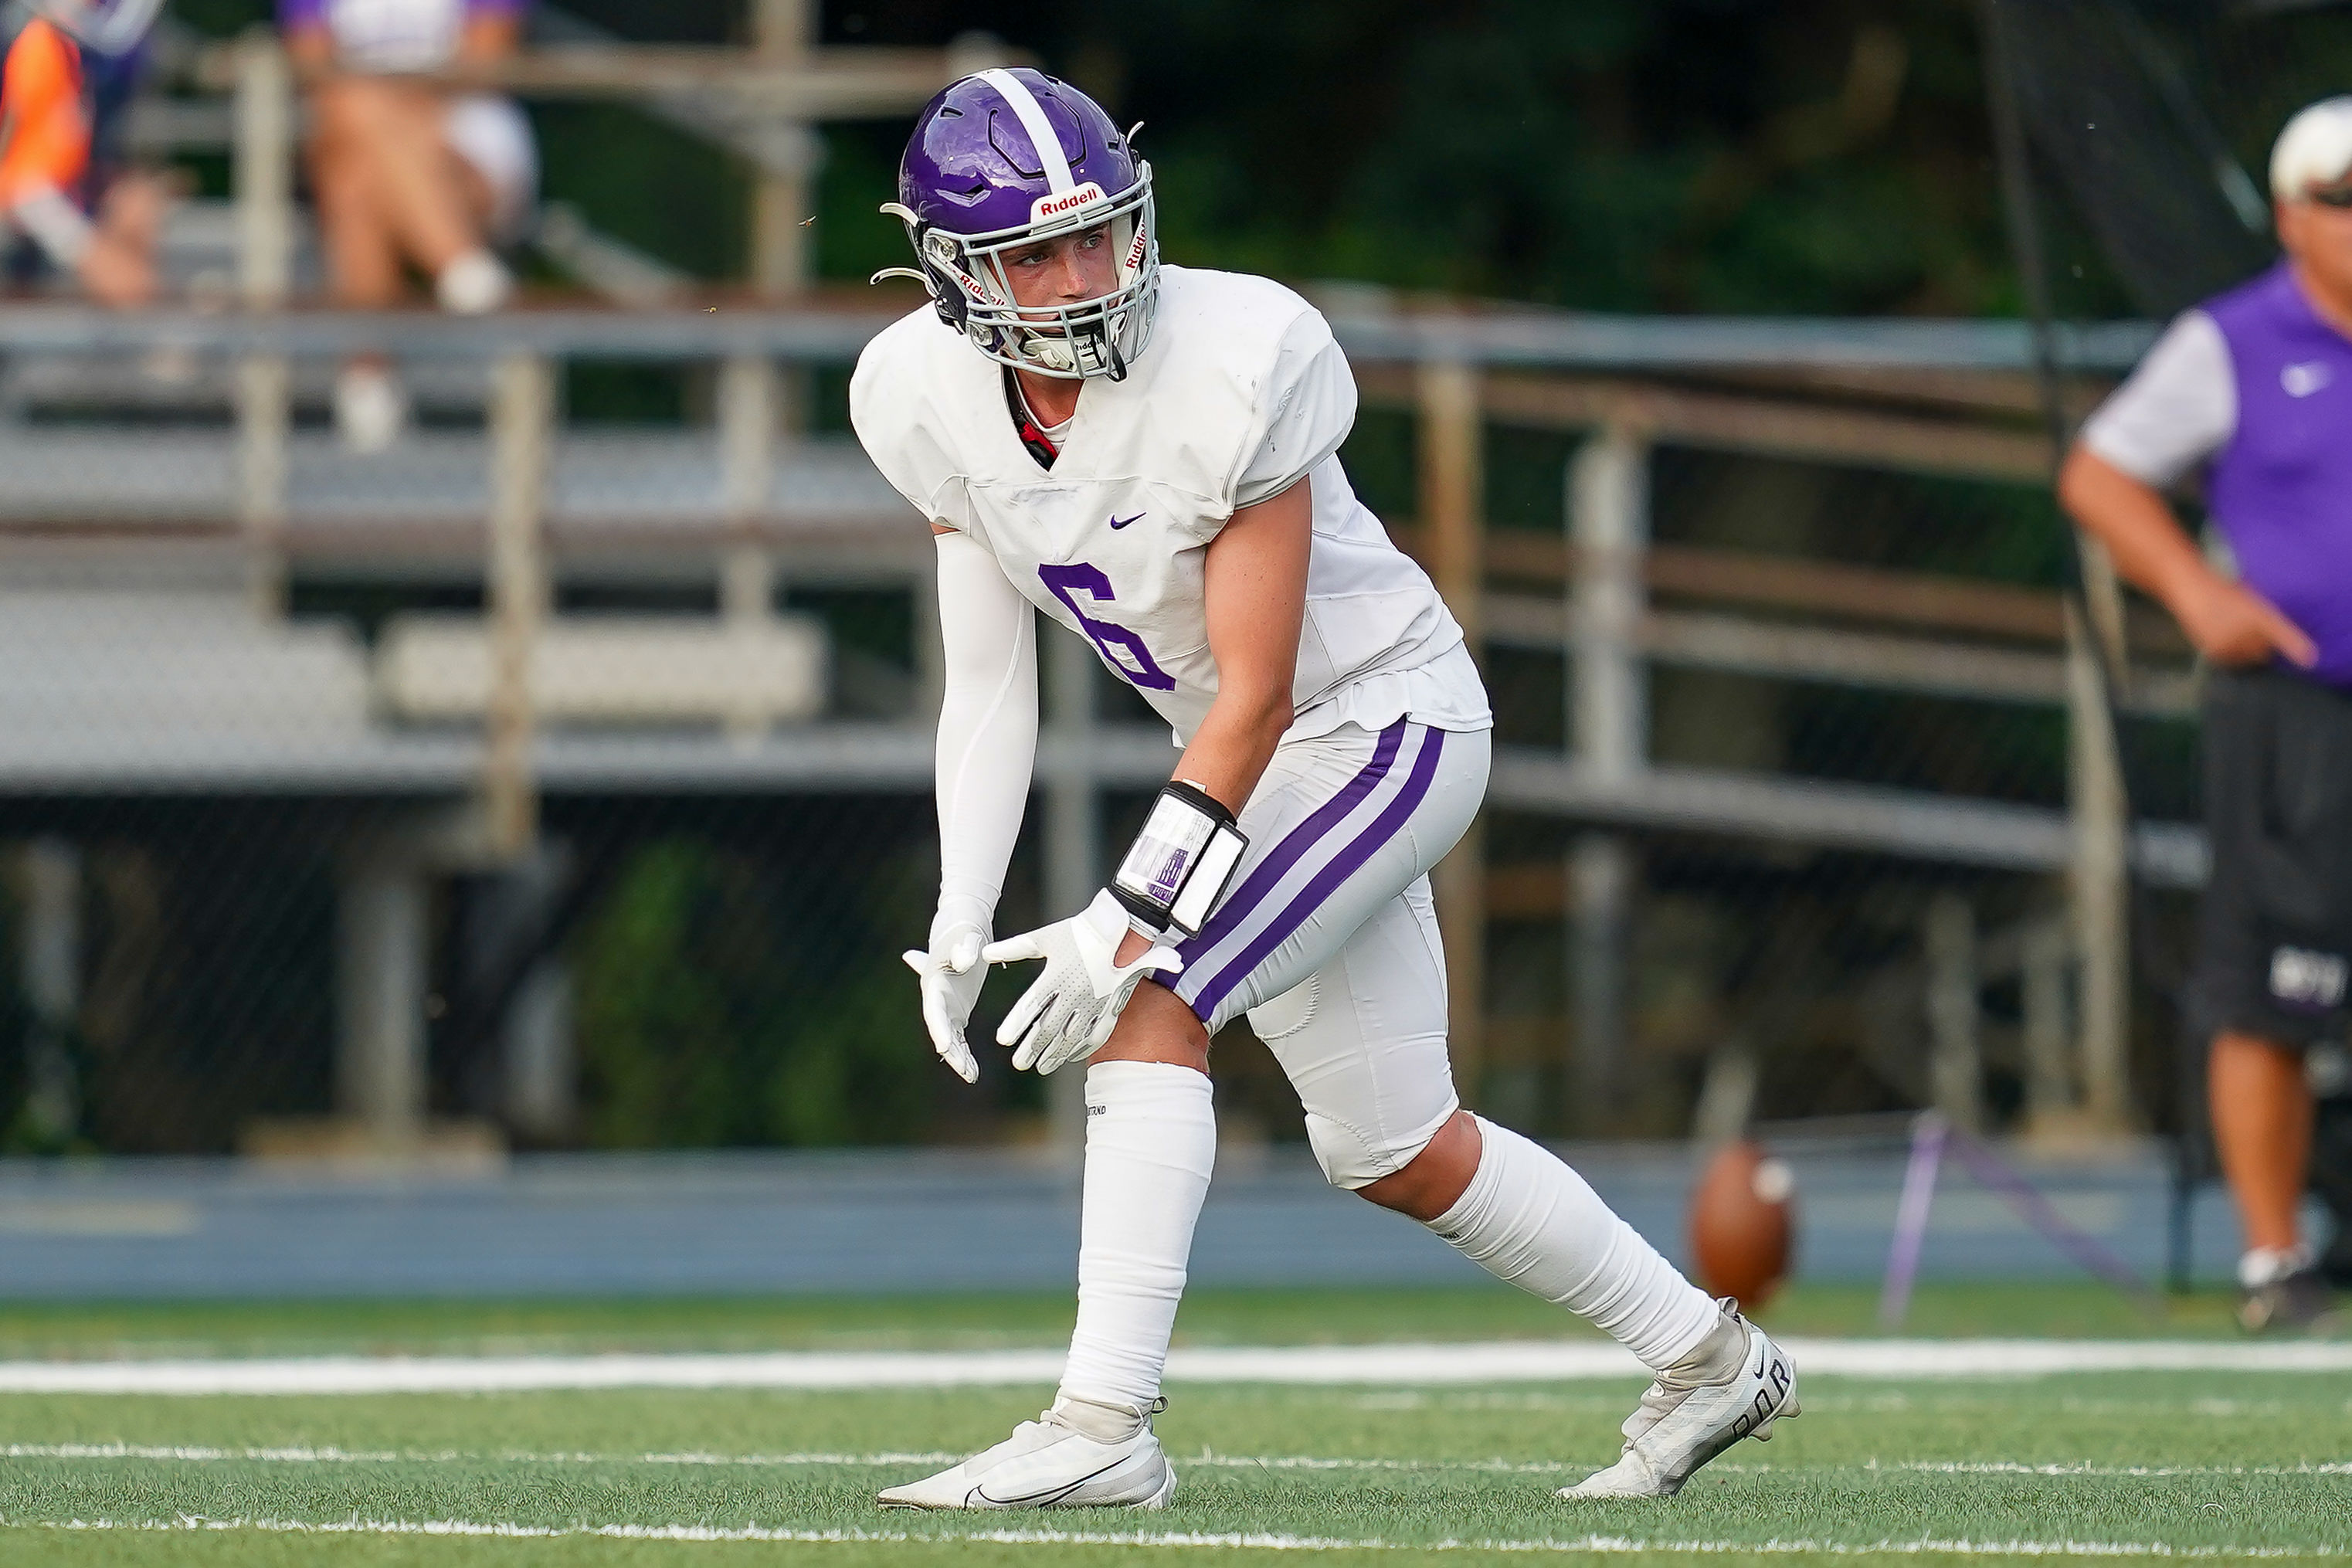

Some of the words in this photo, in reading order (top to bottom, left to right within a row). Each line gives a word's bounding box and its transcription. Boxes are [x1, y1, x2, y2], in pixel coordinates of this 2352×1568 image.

[1040, 188, 1098, 216] Riddell
[1125, 223, 1147, 269] Ridde
[1037, 562, 1177, 692] 6
